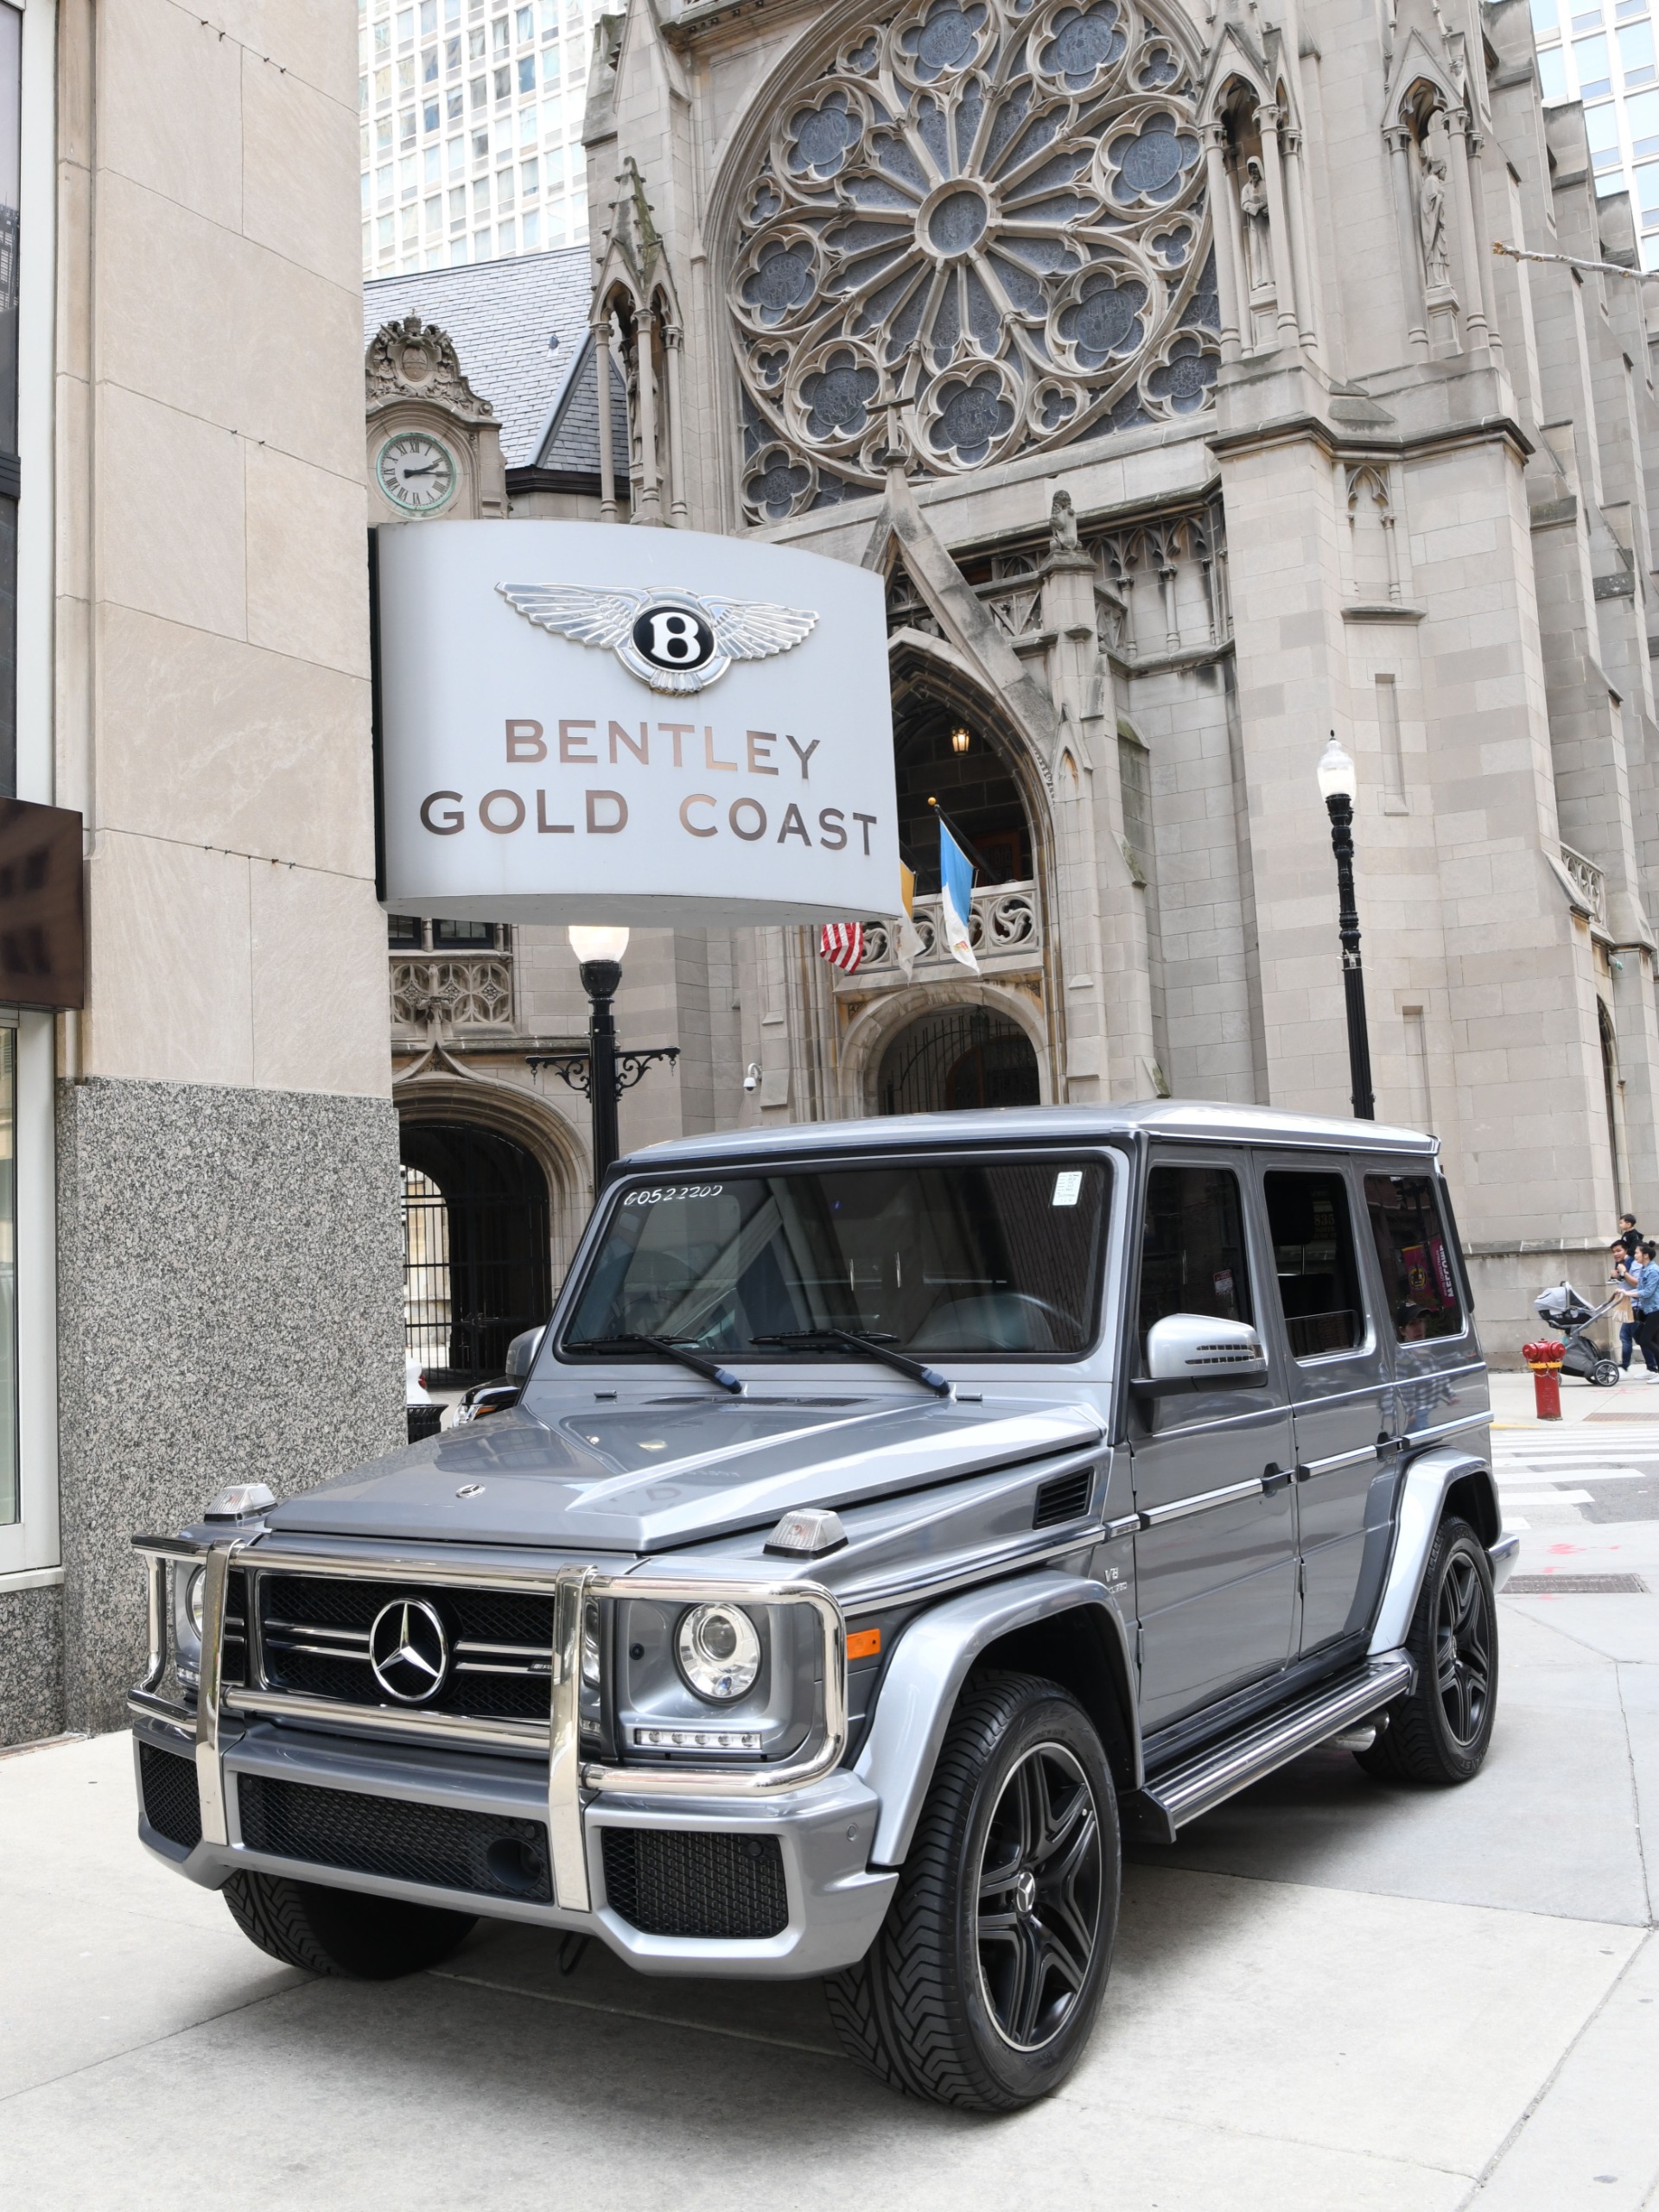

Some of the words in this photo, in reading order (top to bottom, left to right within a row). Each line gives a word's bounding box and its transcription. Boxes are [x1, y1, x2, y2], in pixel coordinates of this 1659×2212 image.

[649, 611, 701, 664] B
[505, 719, 820, 779] BENTLEY
[420, 789, 629, 836] GOLD
[678, 793, 878, 856] COAST
[1105, 1567, 1118, 1582] V8
